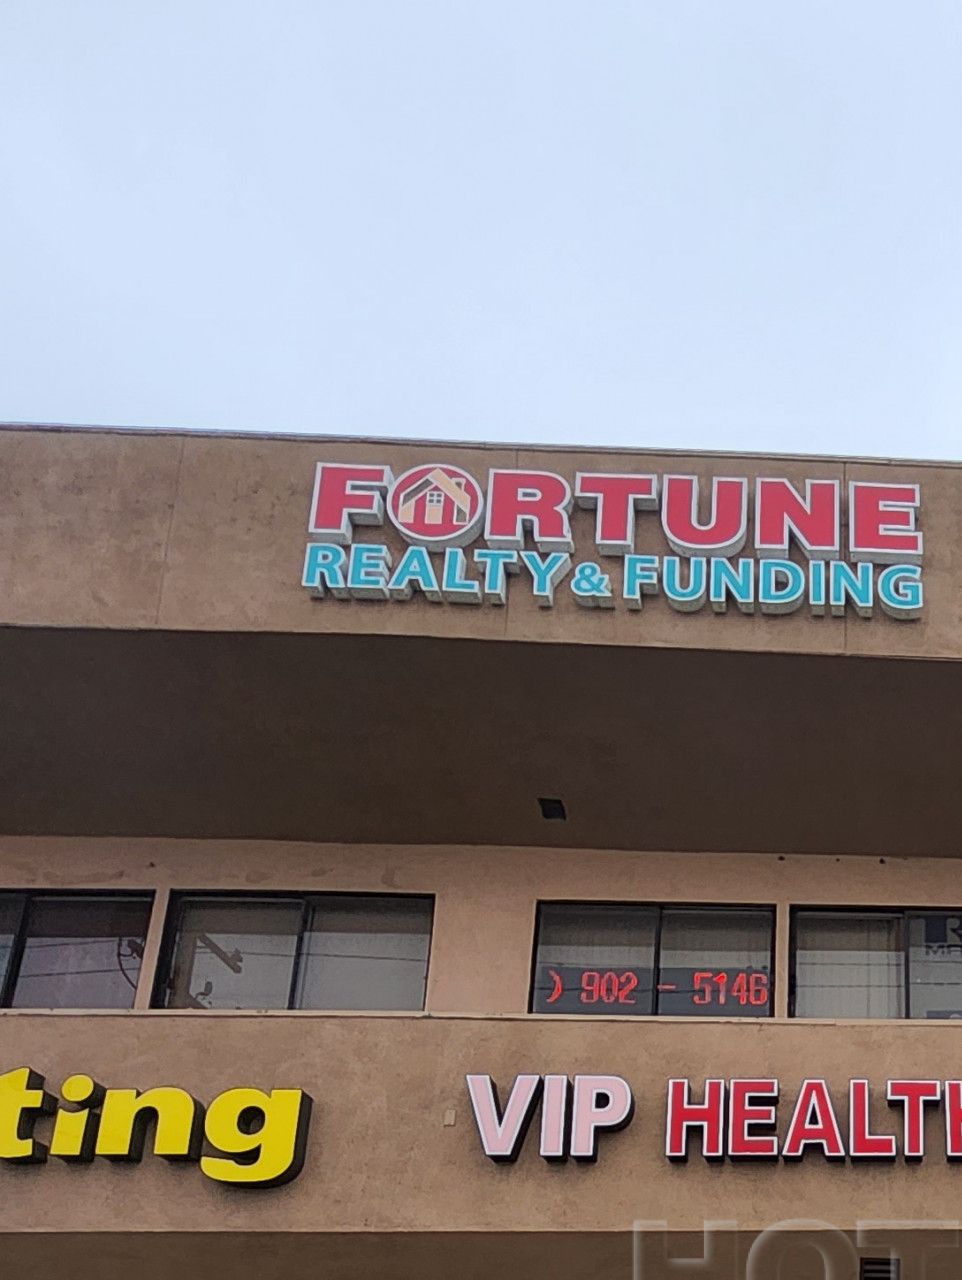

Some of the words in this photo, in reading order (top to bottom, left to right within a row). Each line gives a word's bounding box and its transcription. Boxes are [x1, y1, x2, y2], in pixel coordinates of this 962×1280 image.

[308, 462, 923, 556] FORTUNE
[301, 543, 569, 598] REALTY
[571, 561, 609, 598] &
[623, 554, 923, 609] FUNDING
[580, 971, 638, 1004] 902
[693, 971, 768, 1005] 5146
[466, 1074, 634, 1159] VIP
